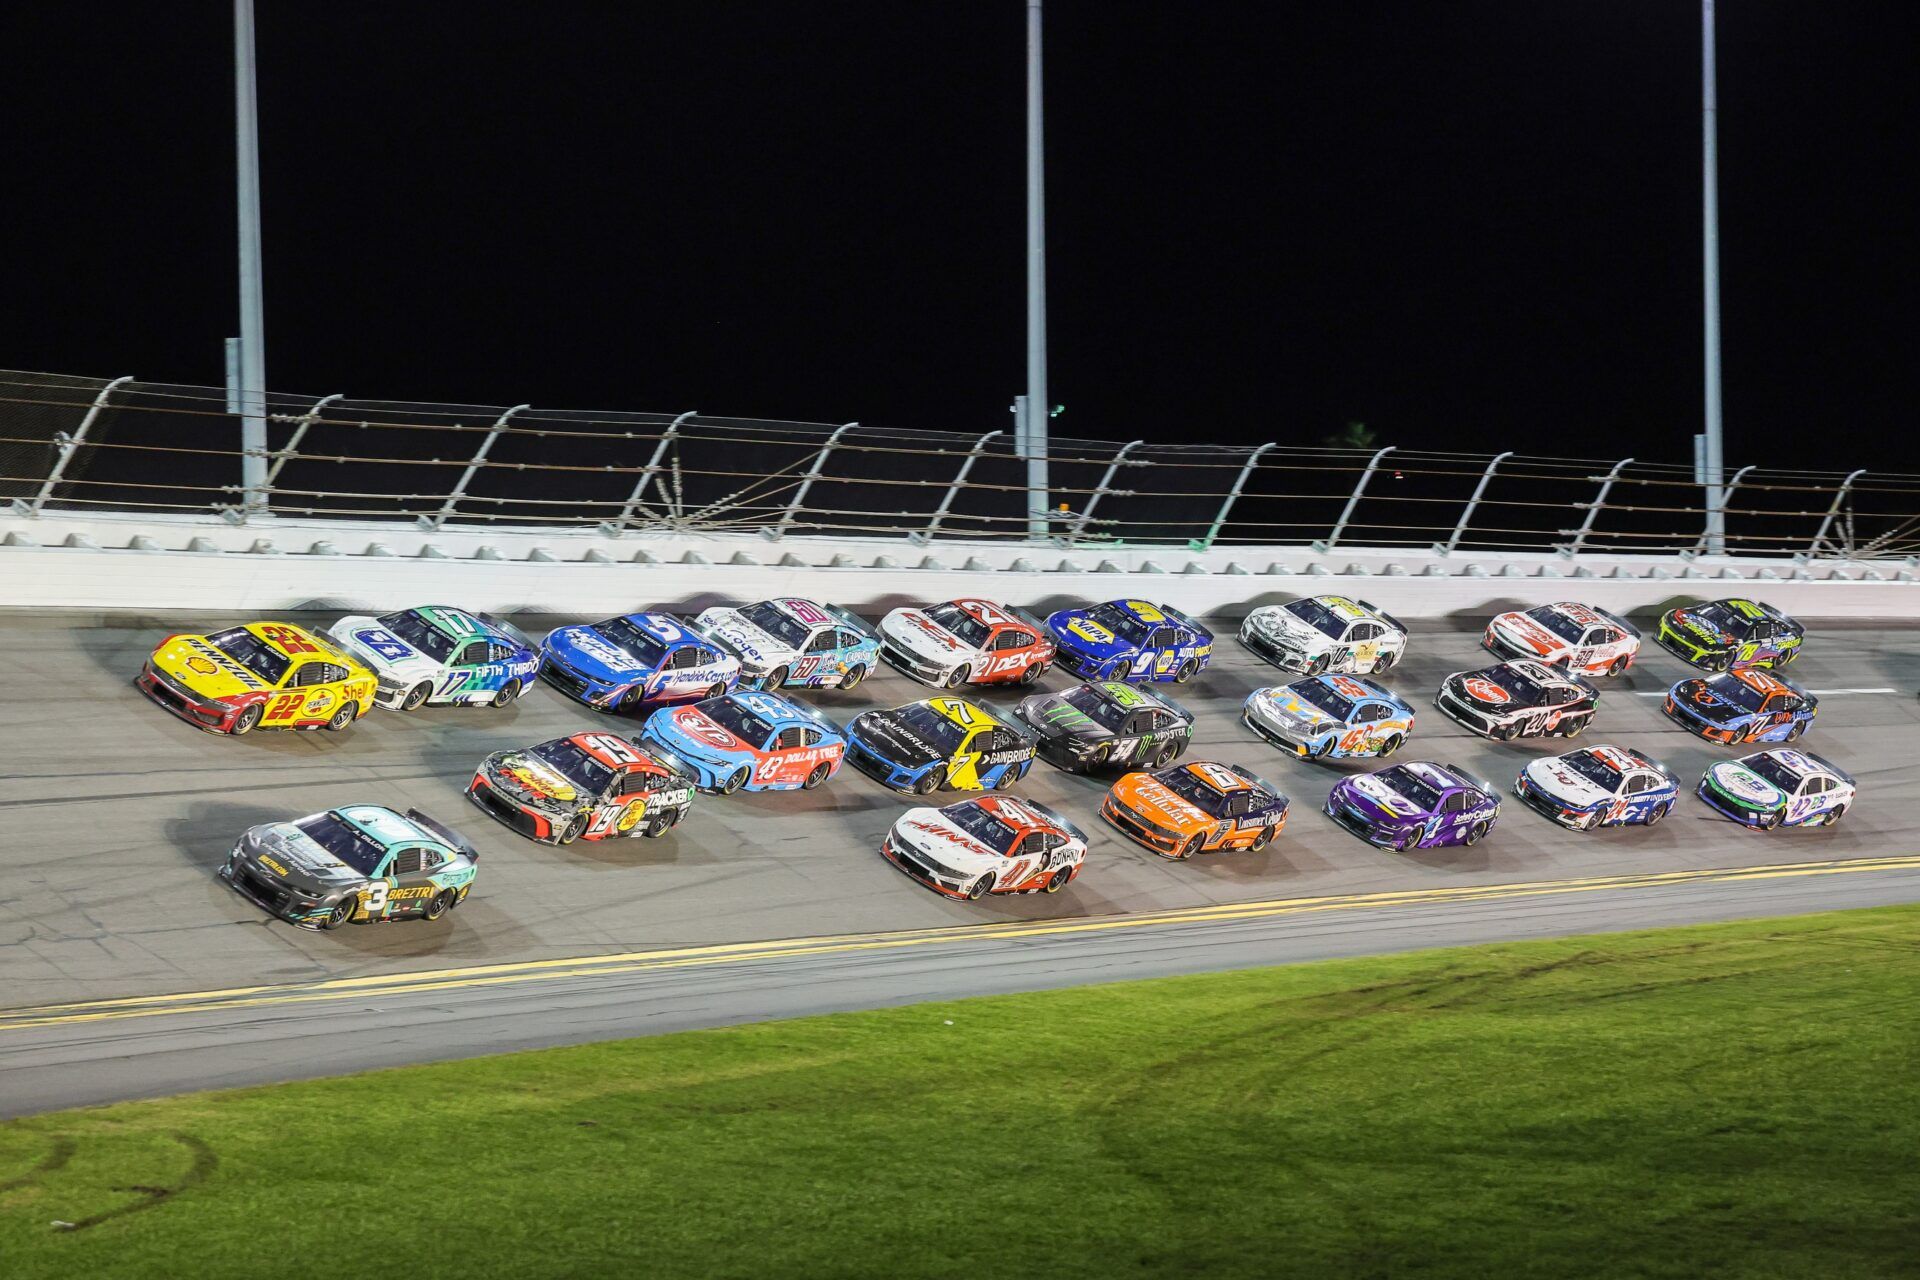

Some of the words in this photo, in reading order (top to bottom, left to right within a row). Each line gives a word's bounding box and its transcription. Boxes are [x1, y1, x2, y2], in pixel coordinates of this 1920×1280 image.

[430, 609, 476, 634] 17
[1074, 620, 1110, 643] NAPA
[993, 651, 1032, 672] DEX
[1132, 652, 1155, 673] 9
[1178, 648, 1194, 657] AUTO
[1571, 650, 1595, 667] 99
[1737, 643, 1761, 661] 78
[183, 638, 264, 689] PENNZOIL
[476, 665, 503, 678] FIFTH
[507, 661, 533, 676] THIRD
[792, 657, 821, 679] 60
[972, 659, 996, 677] 21
[342, 681, 368, 700] Shell
[435, 671, 471, 696] 17
[644, 675, 673, 699] 5
[1743, 671, 1776, 689] 71
[1468, 680, 1505, 703] Rheem
[264, 694, 306, 720] 22
[748, 695, 794, 719] 43
[943, 699, 974, 724] 7
[684, 715, 730, 744] STP
[752, 718, 774, 731] JONES
[947, 721, 967, 733] HALEY
[1528, 712, 1548, 730] 20
[1749, 715, 1771, 735] 71
[880, 717, 943, 760] GAINBRIDGE
[1027, 724, 1051, 741] CAMRY
[1154, 728, 1186, 741] MONSTER
[1339, 729, 1364, 749] 45
[584, 735, 640, 763] 19
[784, 750, 817, 766] DOLLAR
[818, 745, 839, 759] TREE
[990, 747, 1030, 764] GAINBRIDGE
[1108, 737, 1141, 762] 54
[758, 756, 783, 779] 43
[946, 755, 970, 782] 7
[649, 788, 688, 806] TRACKER
[1607, 800, 1628, 819] 24
[1791, 799, 1812, 817] 42
[589, 806, 621, 833] 19
[1428, 817, 1443, 838] 1
[361, 834, 385, 852] DILLON
[364, 882, 389, 911] 3
